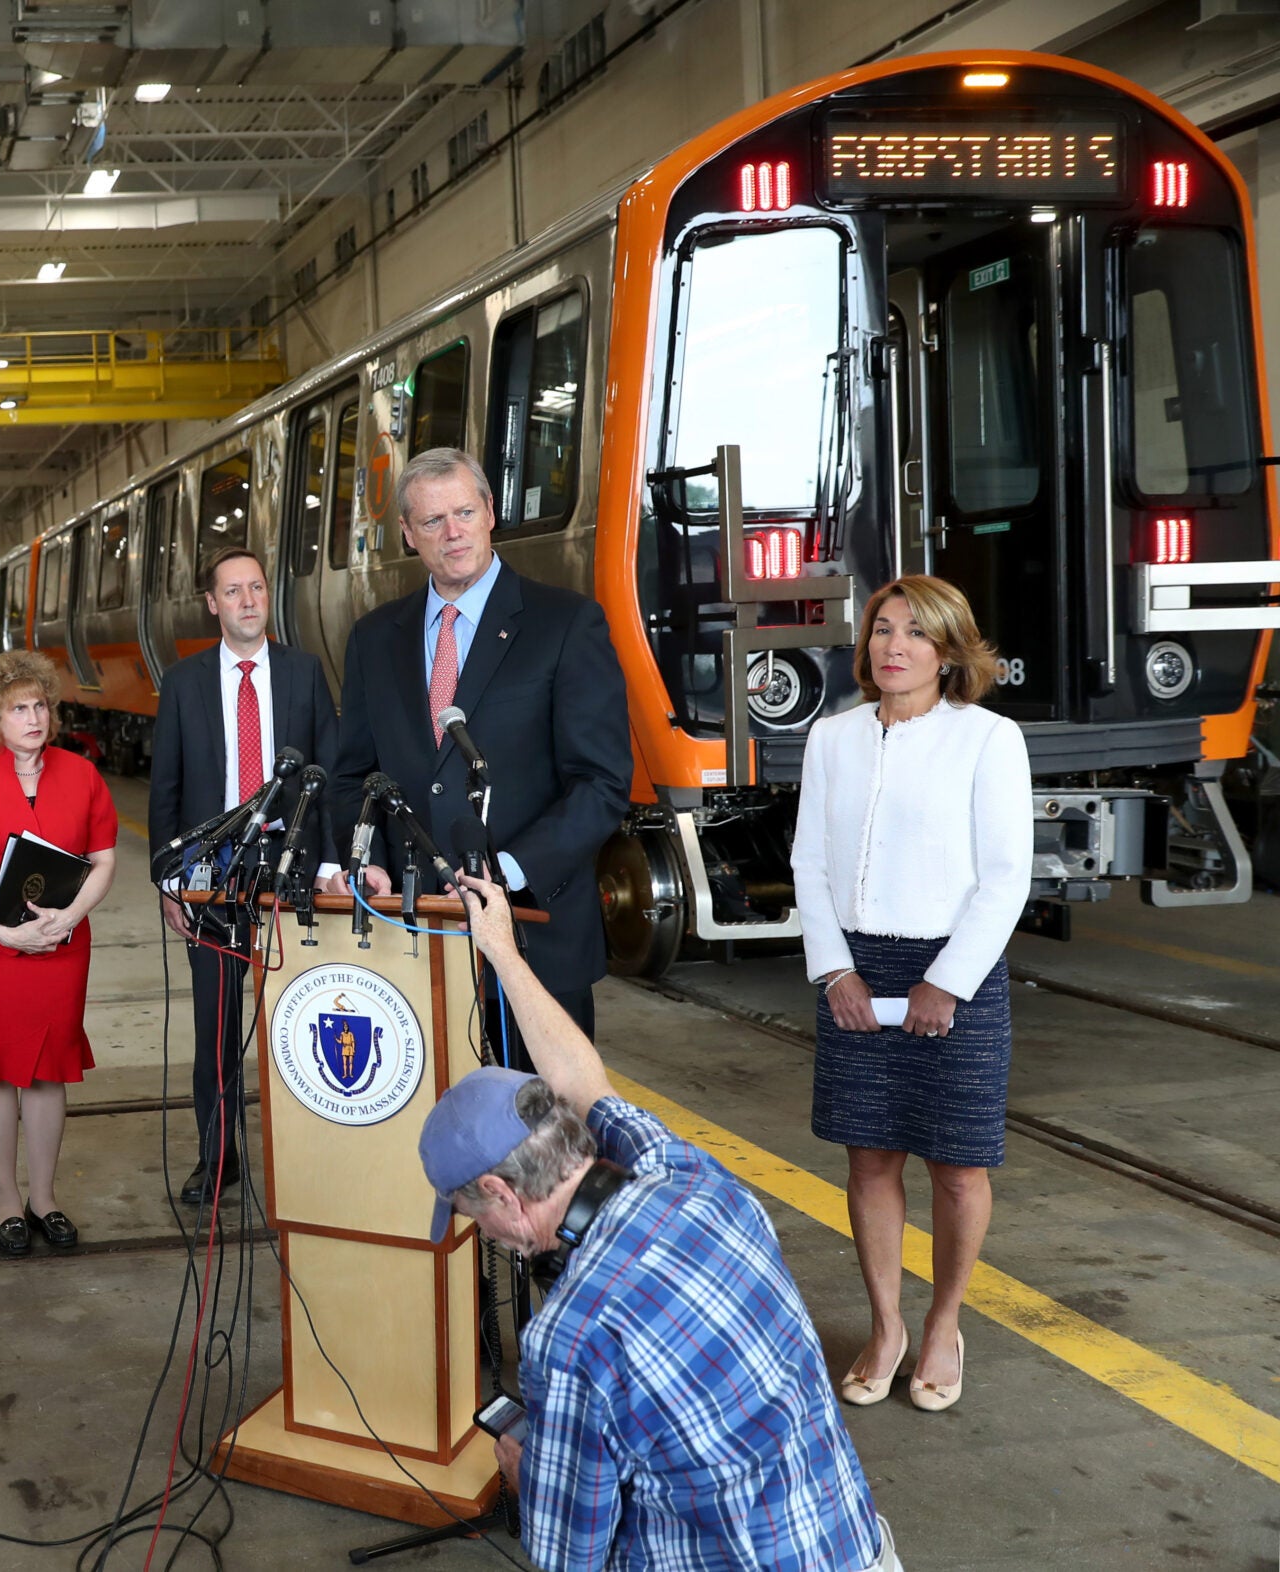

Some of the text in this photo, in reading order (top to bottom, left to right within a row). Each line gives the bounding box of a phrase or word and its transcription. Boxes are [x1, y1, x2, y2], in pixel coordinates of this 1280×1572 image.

[974, 267, 994, 286] EXIT
[372, 362, 395, 391] 1408
[284, 973, 410, 1028] OFFICE OF THE GOVERNOR
[279, 1027, 340, 1114] COMMONWEALTH
[341, 1105, 358, 1116] OF
[359, 1037, 415, 1116] MASSACHUSETTS
